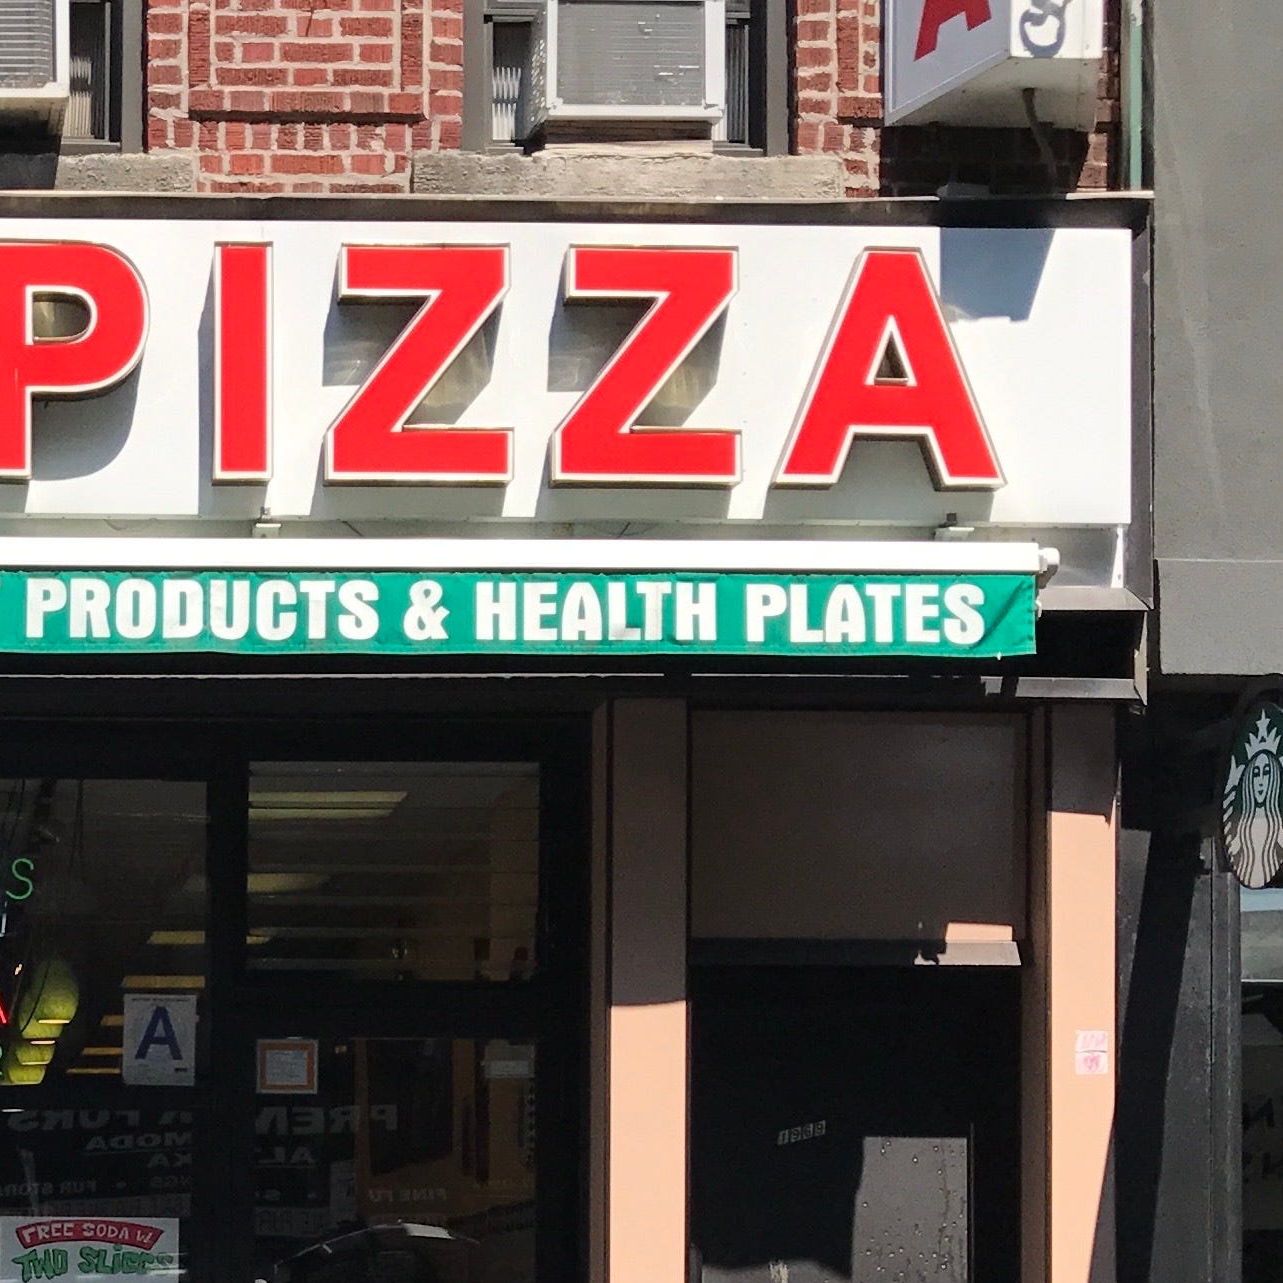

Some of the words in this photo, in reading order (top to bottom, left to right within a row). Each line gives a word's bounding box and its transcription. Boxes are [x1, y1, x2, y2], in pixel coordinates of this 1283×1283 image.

[25, 576, 379, 641] PRODUCTS
[403, 579, 451, 641] &
[475, 580, 717, 642] HEALTH
[745, 582, 986, 645] PLATES
[135, 1006, 183, 1060] A
[22, 1222, 75, 1243] FREE
[82, 1222, 129, 1239] SODA
[11, 1248, 68, 1283] TWO
